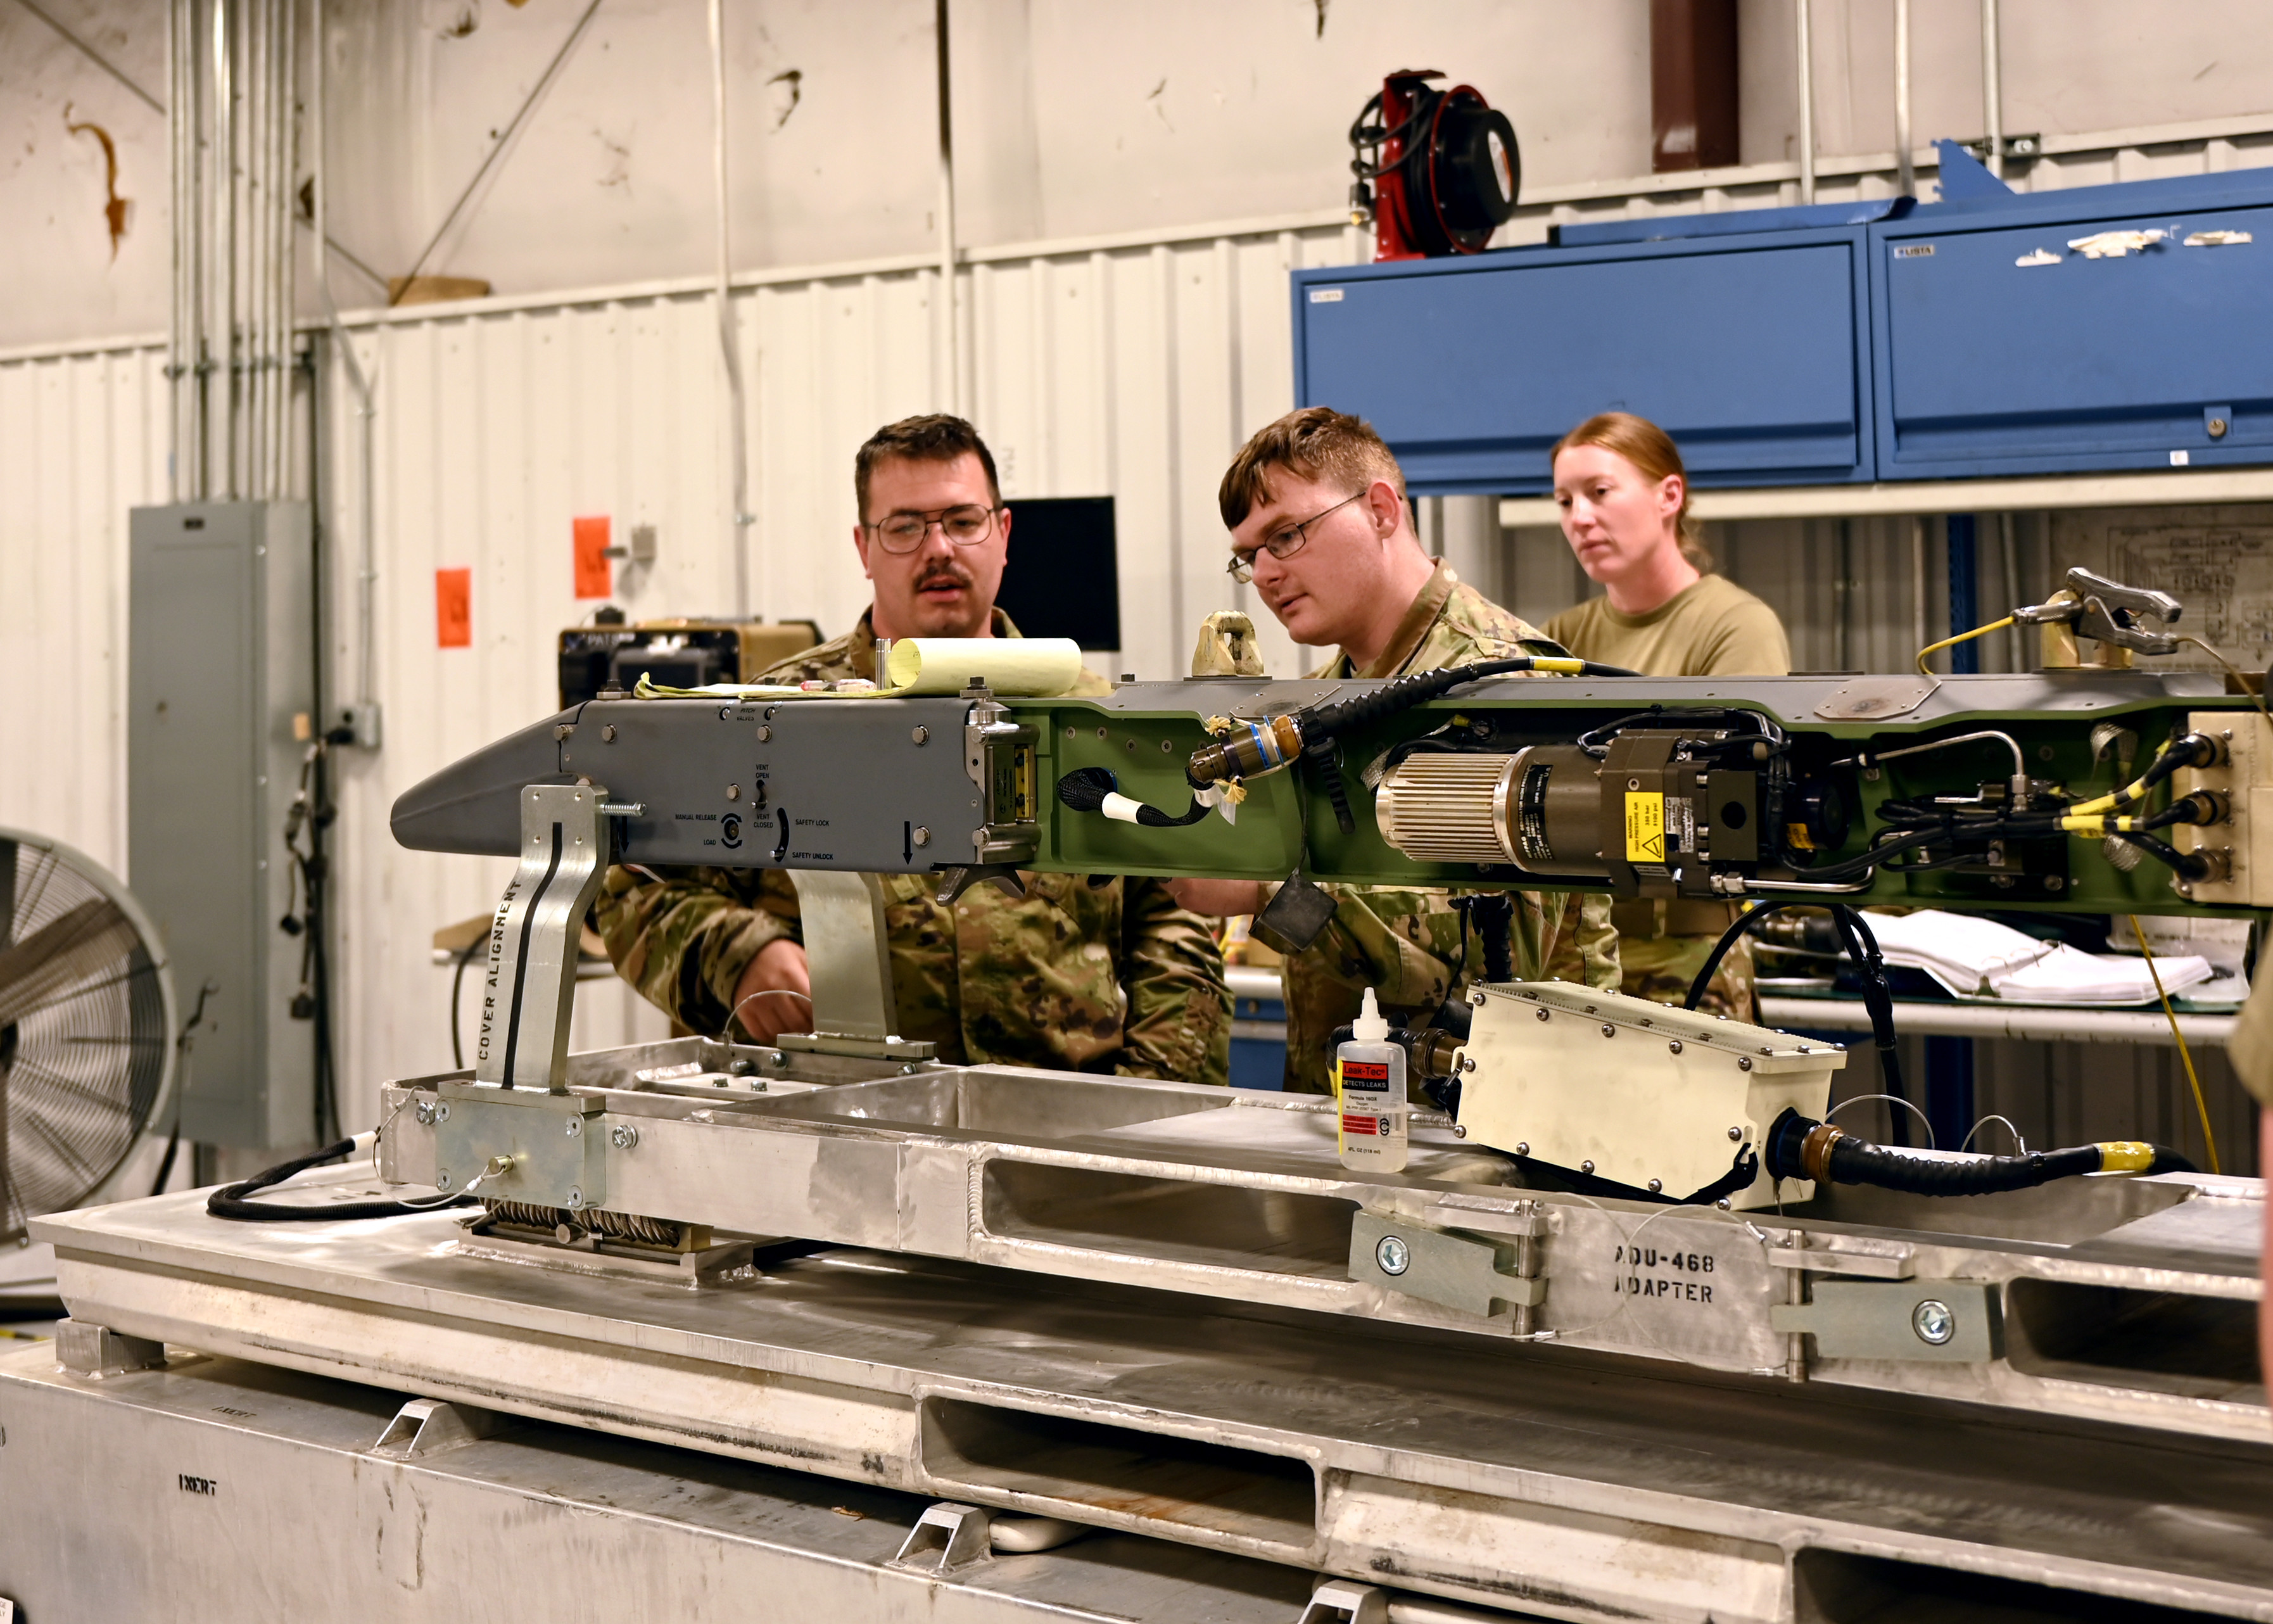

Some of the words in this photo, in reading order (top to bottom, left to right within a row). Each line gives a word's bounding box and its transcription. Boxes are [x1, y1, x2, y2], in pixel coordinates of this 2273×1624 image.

[479, 997, 495, 1060] COVER
[488, 881, 522, 987] ALIGNMENT
[1343, 1079, 1365, 1088] DETECTS
[1615, 1245, 1714, 1272] ADU-468
[212, 1405, 257, 1418] INERT
[179, 1473, 217, 1496] INERT
